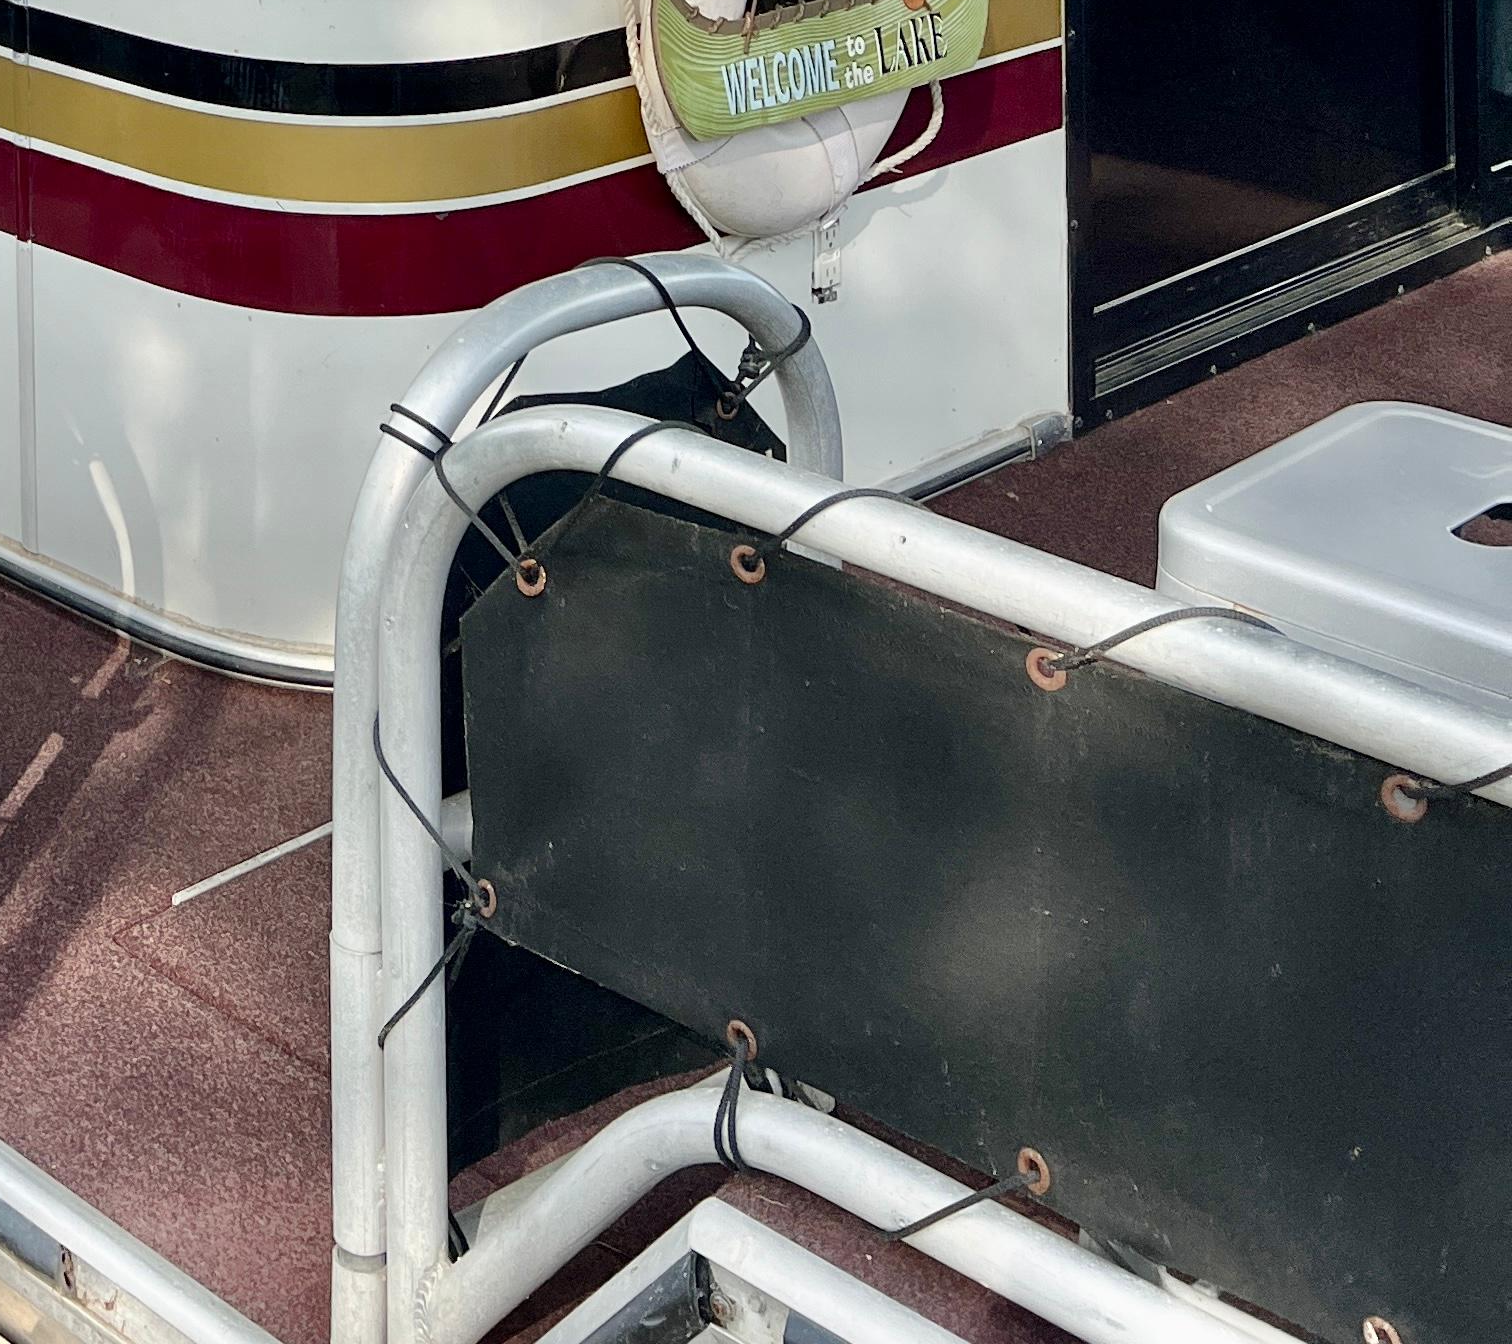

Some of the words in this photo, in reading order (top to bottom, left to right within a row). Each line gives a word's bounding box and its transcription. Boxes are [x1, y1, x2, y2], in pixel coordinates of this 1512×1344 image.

[844, 33, 867, 58] to
[873, 12, 949, 78] LAKE
[720, 38, 842, 117] WELCOME
[843, 61, 875, 89] the
